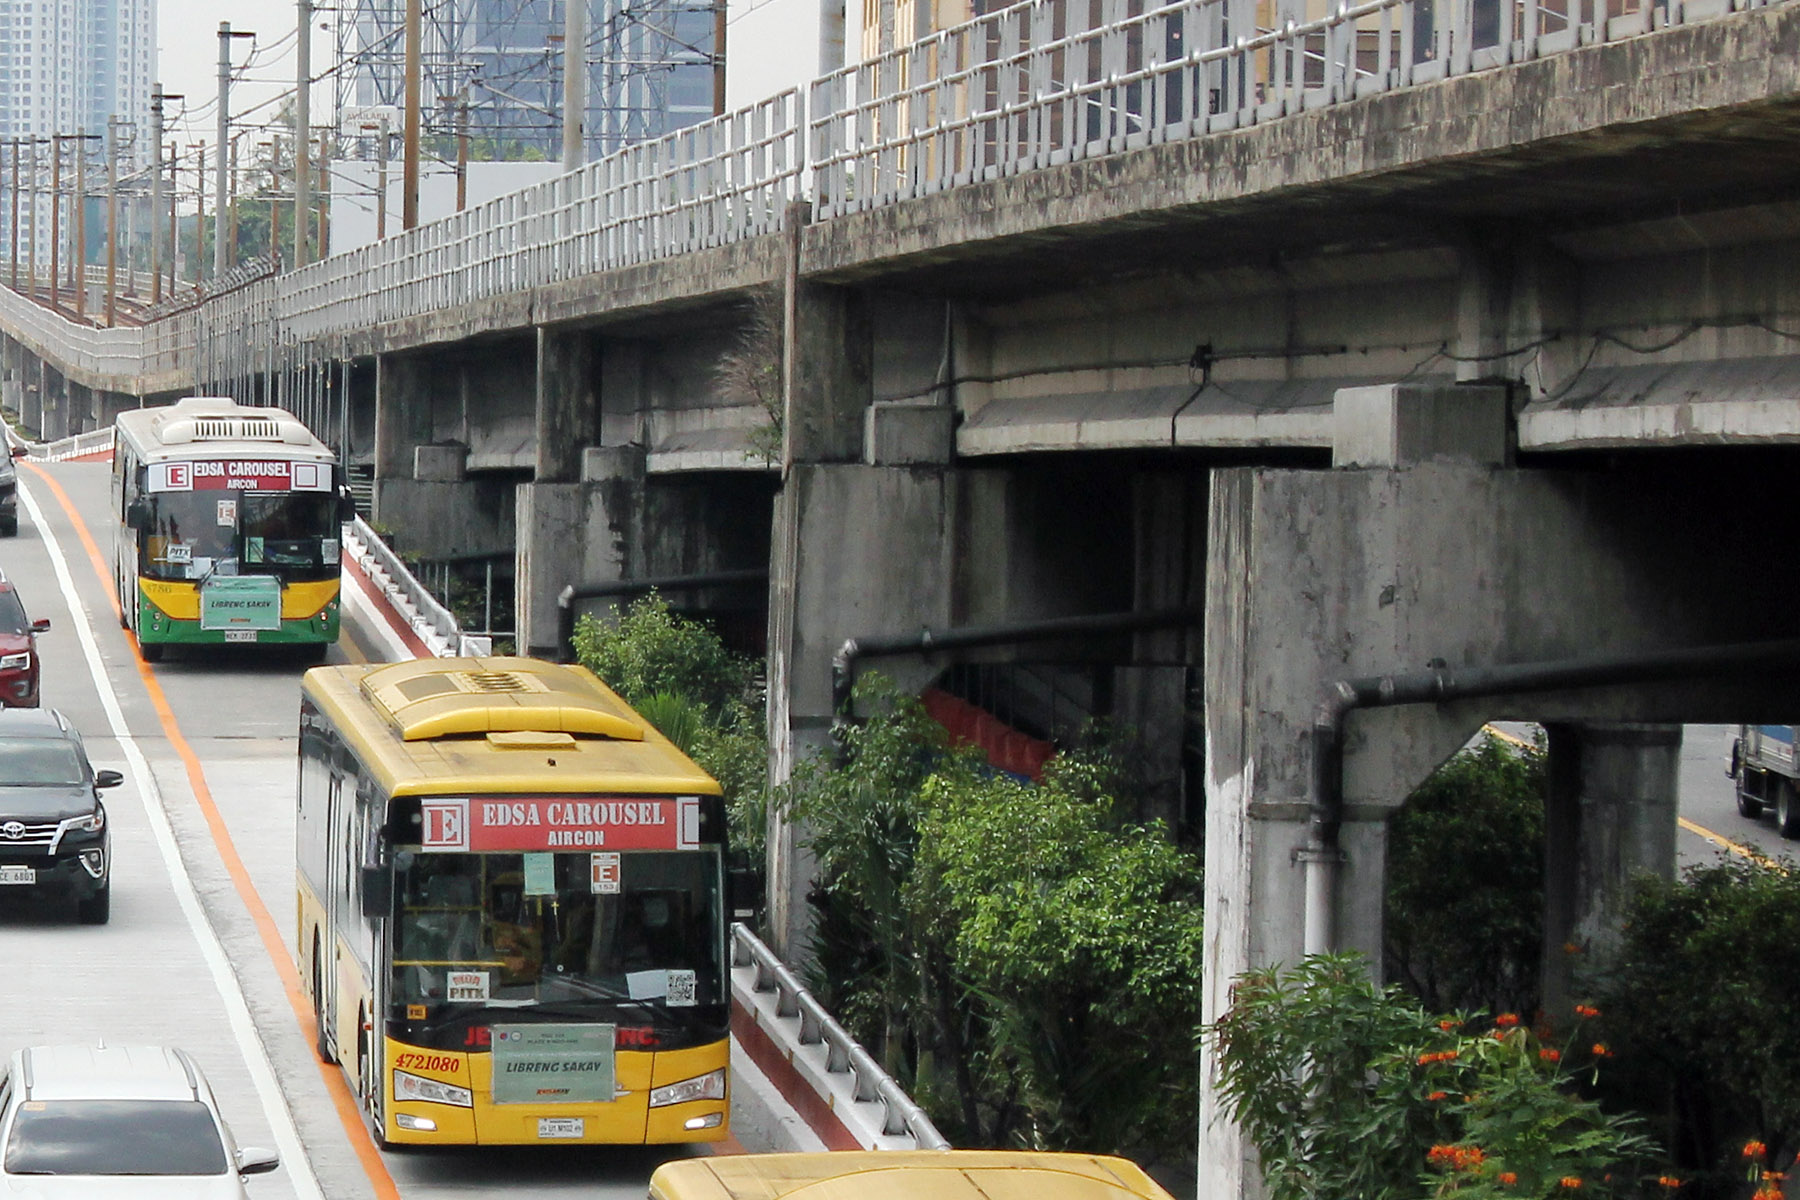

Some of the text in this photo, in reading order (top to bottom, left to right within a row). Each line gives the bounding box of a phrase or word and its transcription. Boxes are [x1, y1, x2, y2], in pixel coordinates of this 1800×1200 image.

[171, 468, 185, 483] E
[194, 461, 290, 477] EDSA CAROUSEL
[227, 479, 257, 489] AIRCON
[483, 802, 665, 826] EDSA CAROUSEL
[429, 810, 458, 843] E
[548, 831, 604, 846] AIRCON
[600, 865, 612, 882] E
[396, 1053, 460, 1073] 4721080
[506, 1062, 601, 1073] LIBRENG SAKAY
